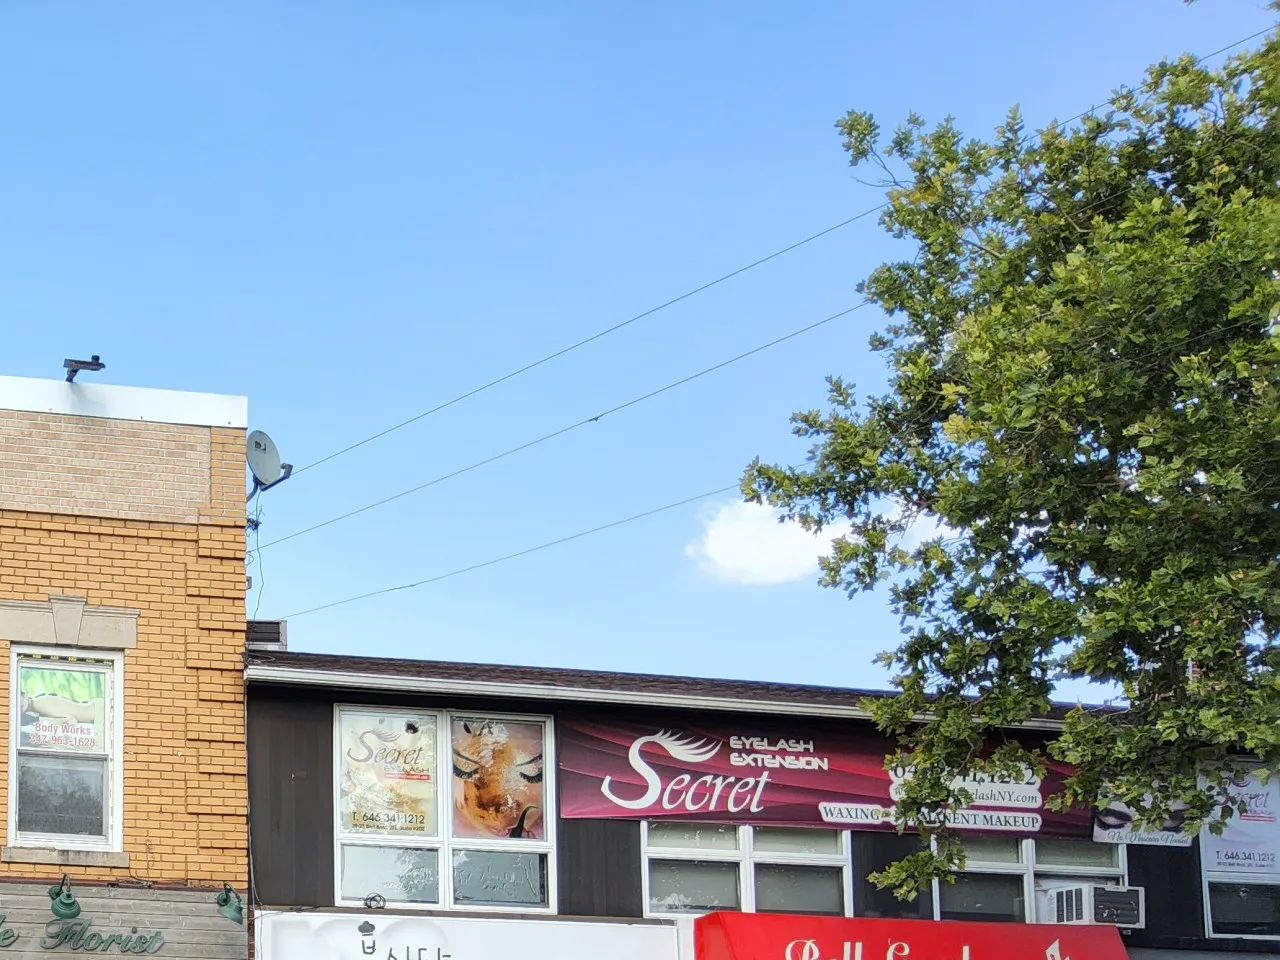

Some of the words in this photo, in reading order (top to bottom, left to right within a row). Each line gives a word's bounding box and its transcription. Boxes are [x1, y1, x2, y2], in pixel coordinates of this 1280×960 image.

[35, 722, 58, 735] Body
[61, 723, 91, 736] Works
[30, 734, 96, 747] 347-963-1628
[347, 729, 424, 764] Secret
[729, 735, 814, 753] EYELASH
[383, 765, 430, 774] EYELASH
[729, 752, 829, 771] EXTENSION
[601, 728, 773, 814] Secret
[363, 812, 425, 825] 646.341.1212
[823, 804, 881, 821] WAXING
[982, 813, 1039, 828] MAKEUP
[1124, 832, 1160, 844] Mascara
[1160, 833, 1190, 844] Needed
[1224, 851, 1276, 862] 646.341.1212
[39, 917, 166, 954] Florist
